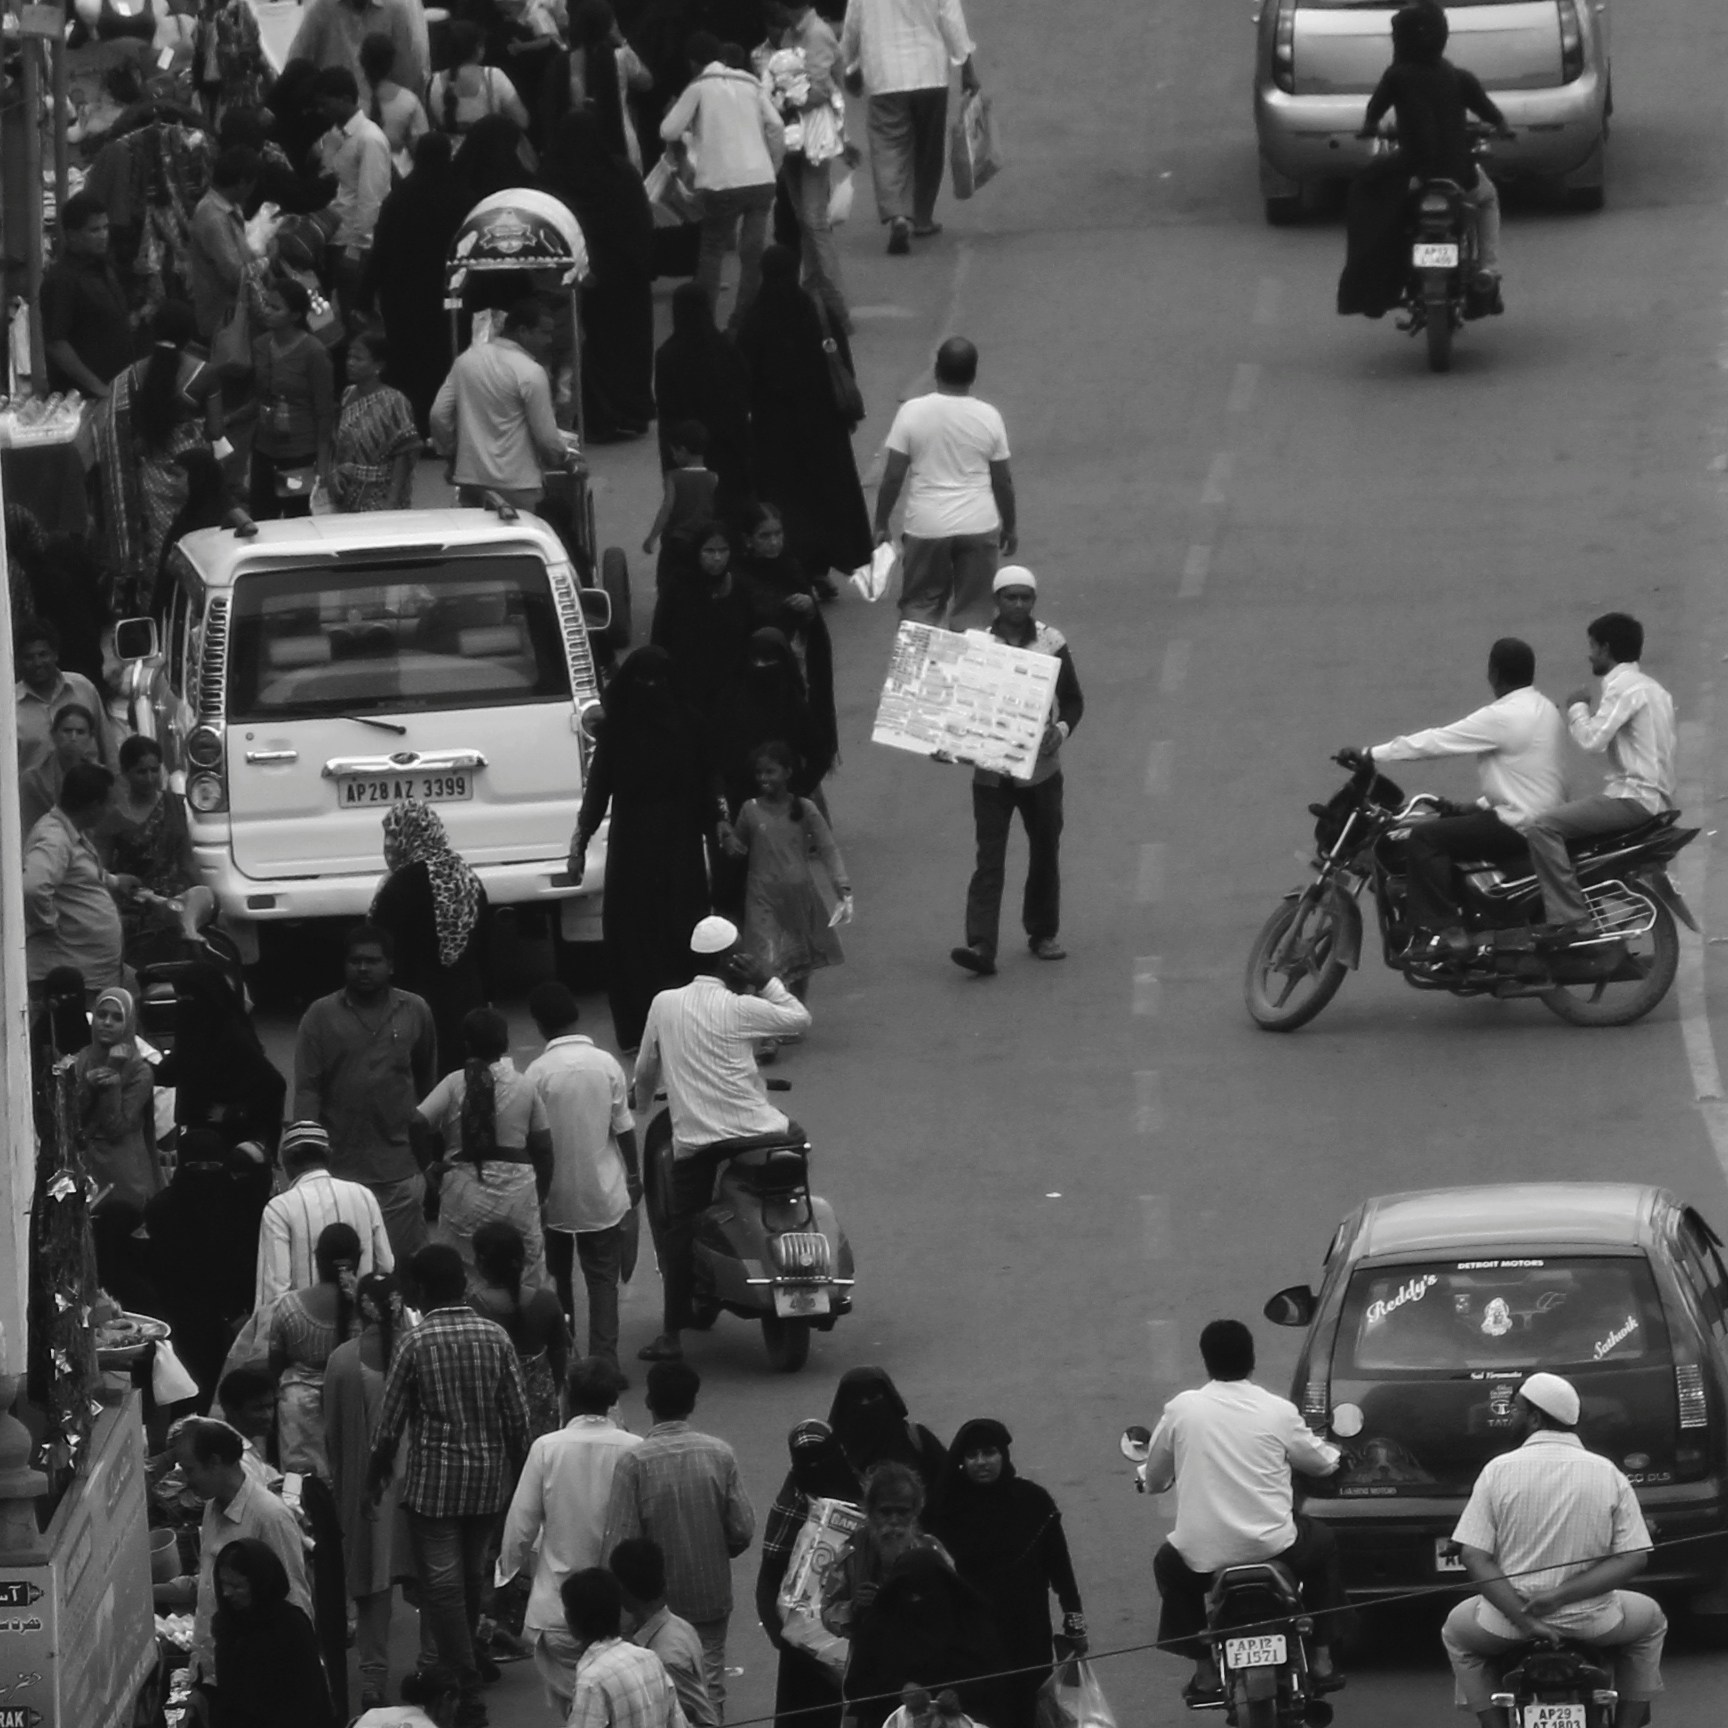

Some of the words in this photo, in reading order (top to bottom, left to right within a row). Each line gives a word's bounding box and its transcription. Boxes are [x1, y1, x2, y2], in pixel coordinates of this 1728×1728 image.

[346, 778, 391, 804] AP28
[393, 777, 415, 800] AZ
[423, 774, 467, 798] 3399
[1457, 1262, 1500, 1270] DETROIT
[1501, 1260, 1544, 1269] MOTORS
[1366, 1274, 1438, 1321] Reddy's
[1246, 1647, 1278, 1662] 1571
[1540, 1708, 1573, 1721] AP29
